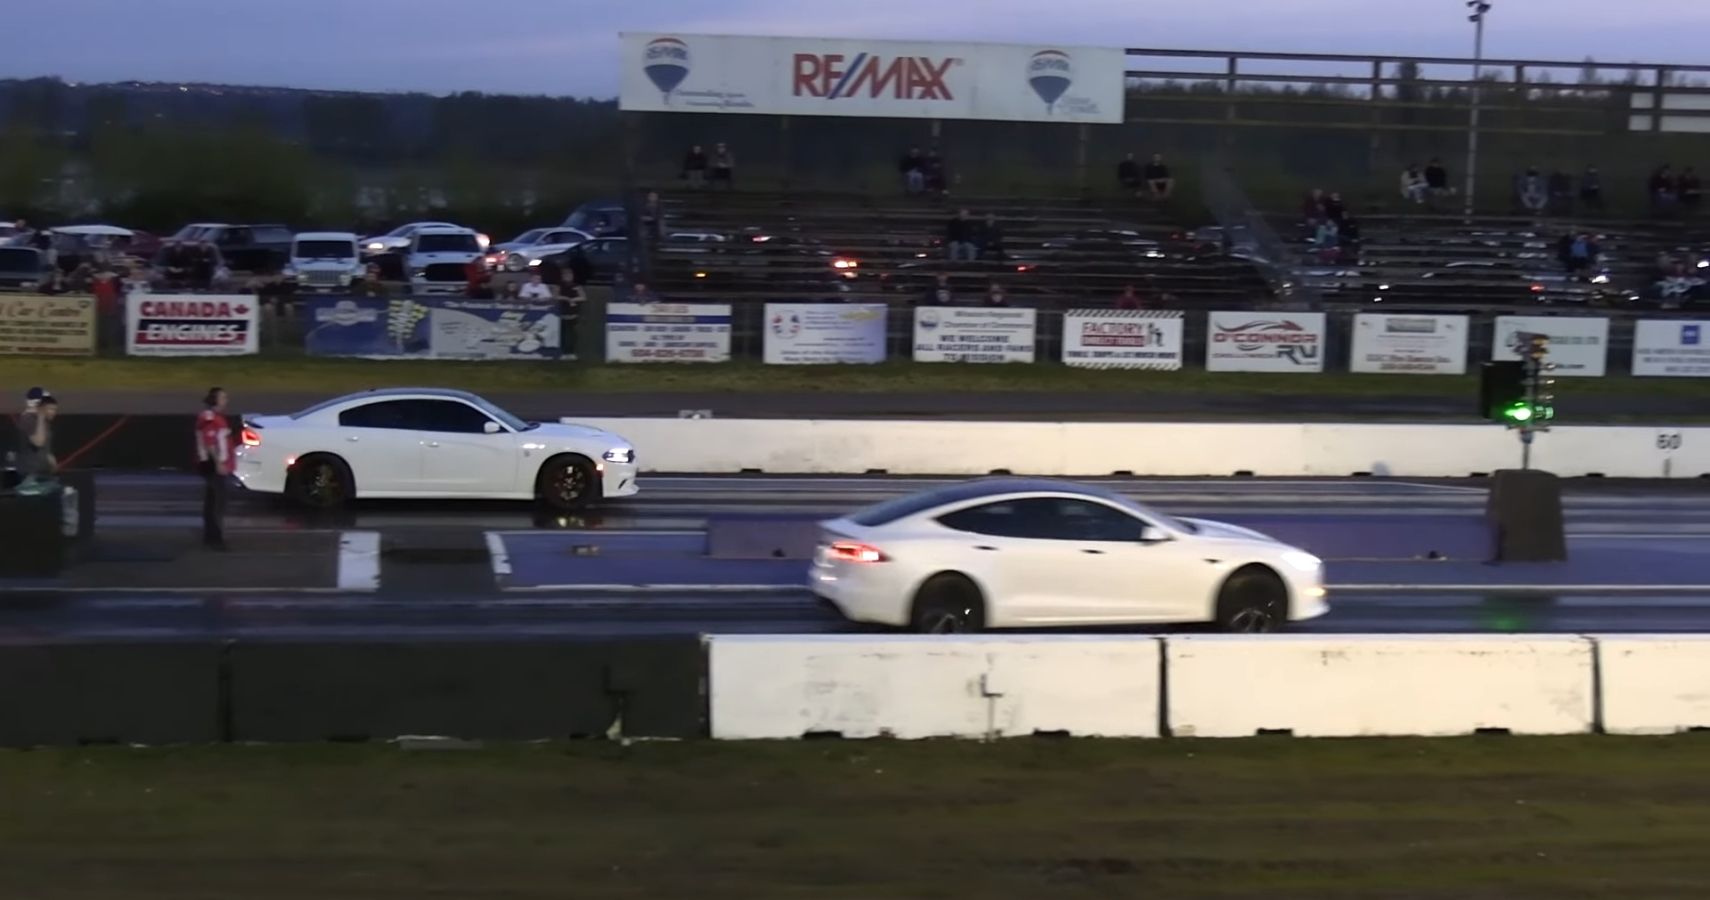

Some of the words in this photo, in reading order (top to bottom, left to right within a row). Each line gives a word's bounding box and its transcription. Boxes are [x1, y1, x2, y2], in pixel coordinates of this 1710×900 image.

[793, 52, 954, 101] RE/MAX
[139, 301, 232, 318] CANADA
[147, 322, 239, 341] ENGINES
[1082, 322, 1144, 334] FACTORY
[959, 335, 1010, 343] WELCOME
[1213, 332, 1317, 343] O'CONNOR
[937, 344, 979, 352] RACERS
[1276, 344, 1317, 365] RV
[1656, 433, 1682, 450] 60
